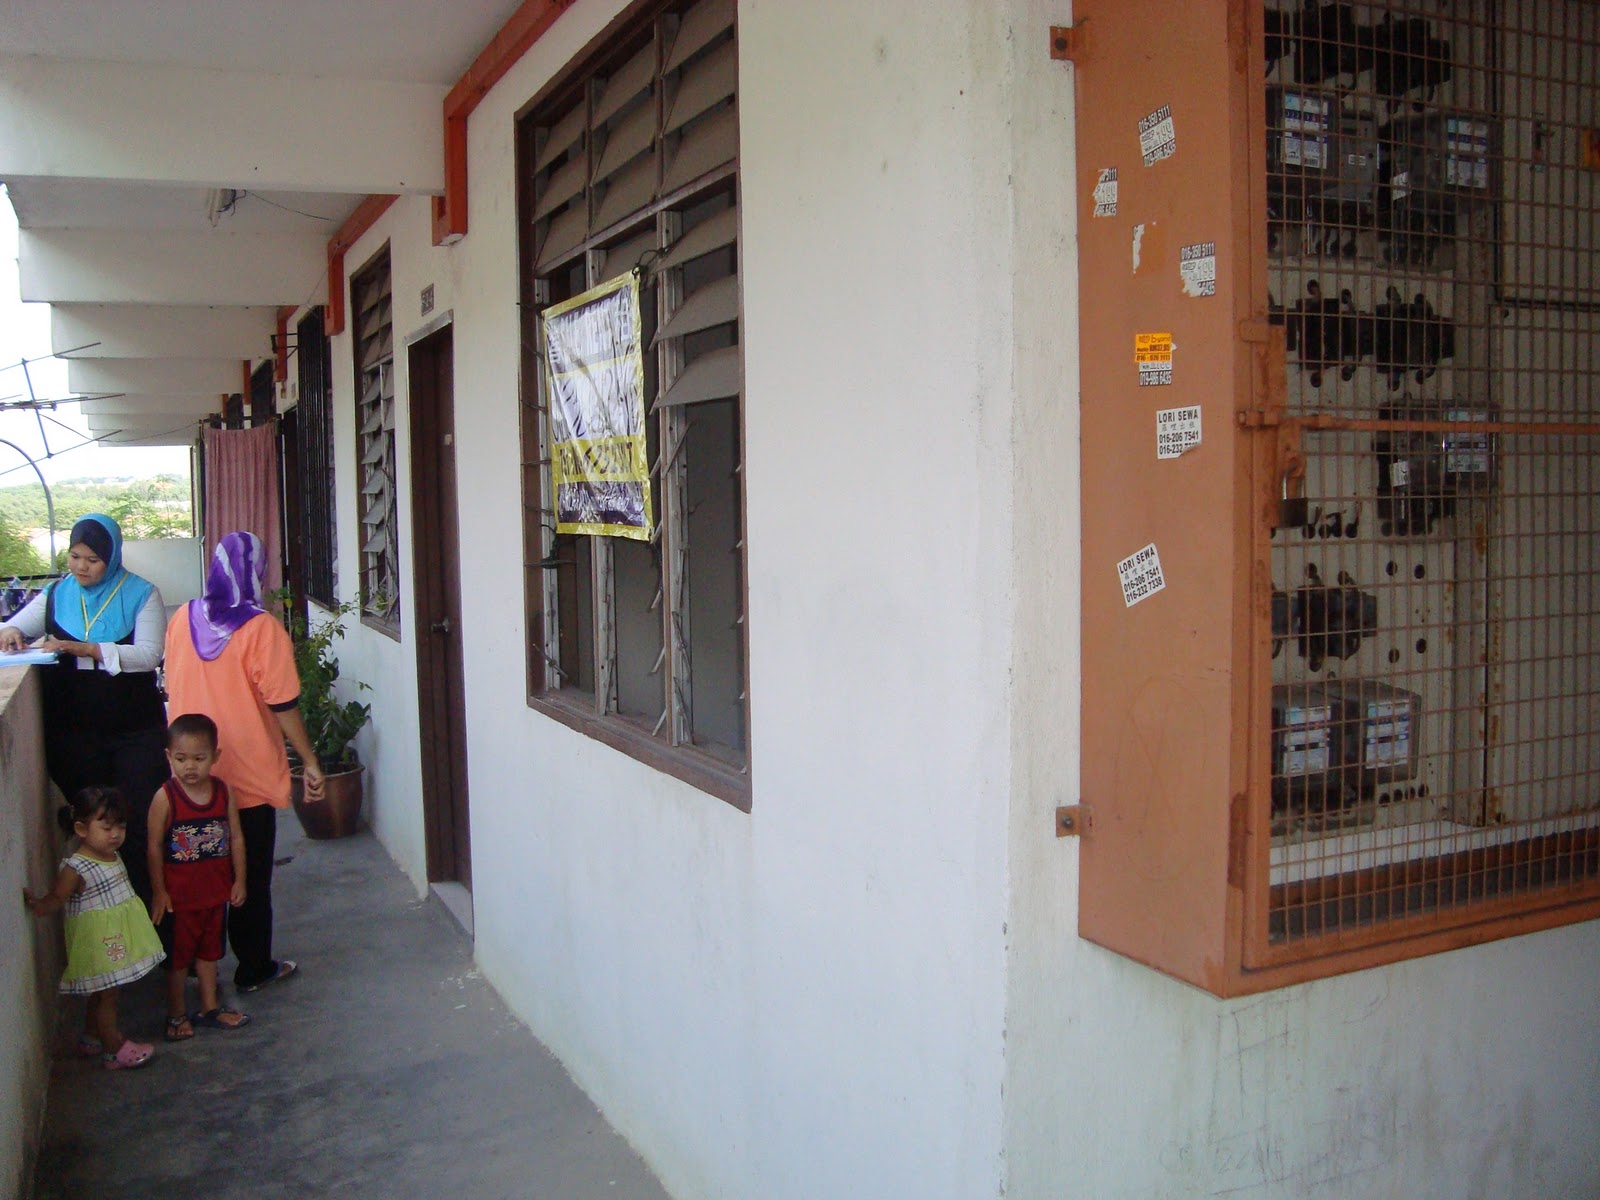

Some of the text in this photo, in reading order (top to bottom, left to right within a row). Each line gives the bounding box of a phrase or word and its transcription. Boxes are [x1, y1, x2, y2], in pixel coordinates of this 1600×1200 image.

[1158, 409, 1198, 423] LORI SEWA
[1159, 430, 1199, 444] 016-206 7541
[1159, 443, 1183, 455] 016-232
[1118, 547, 1155, 574] LORI SEWA
[1123, 566, 1160, 593] 016-206 7541
[1126, 584, 1148, 603] 016-232
